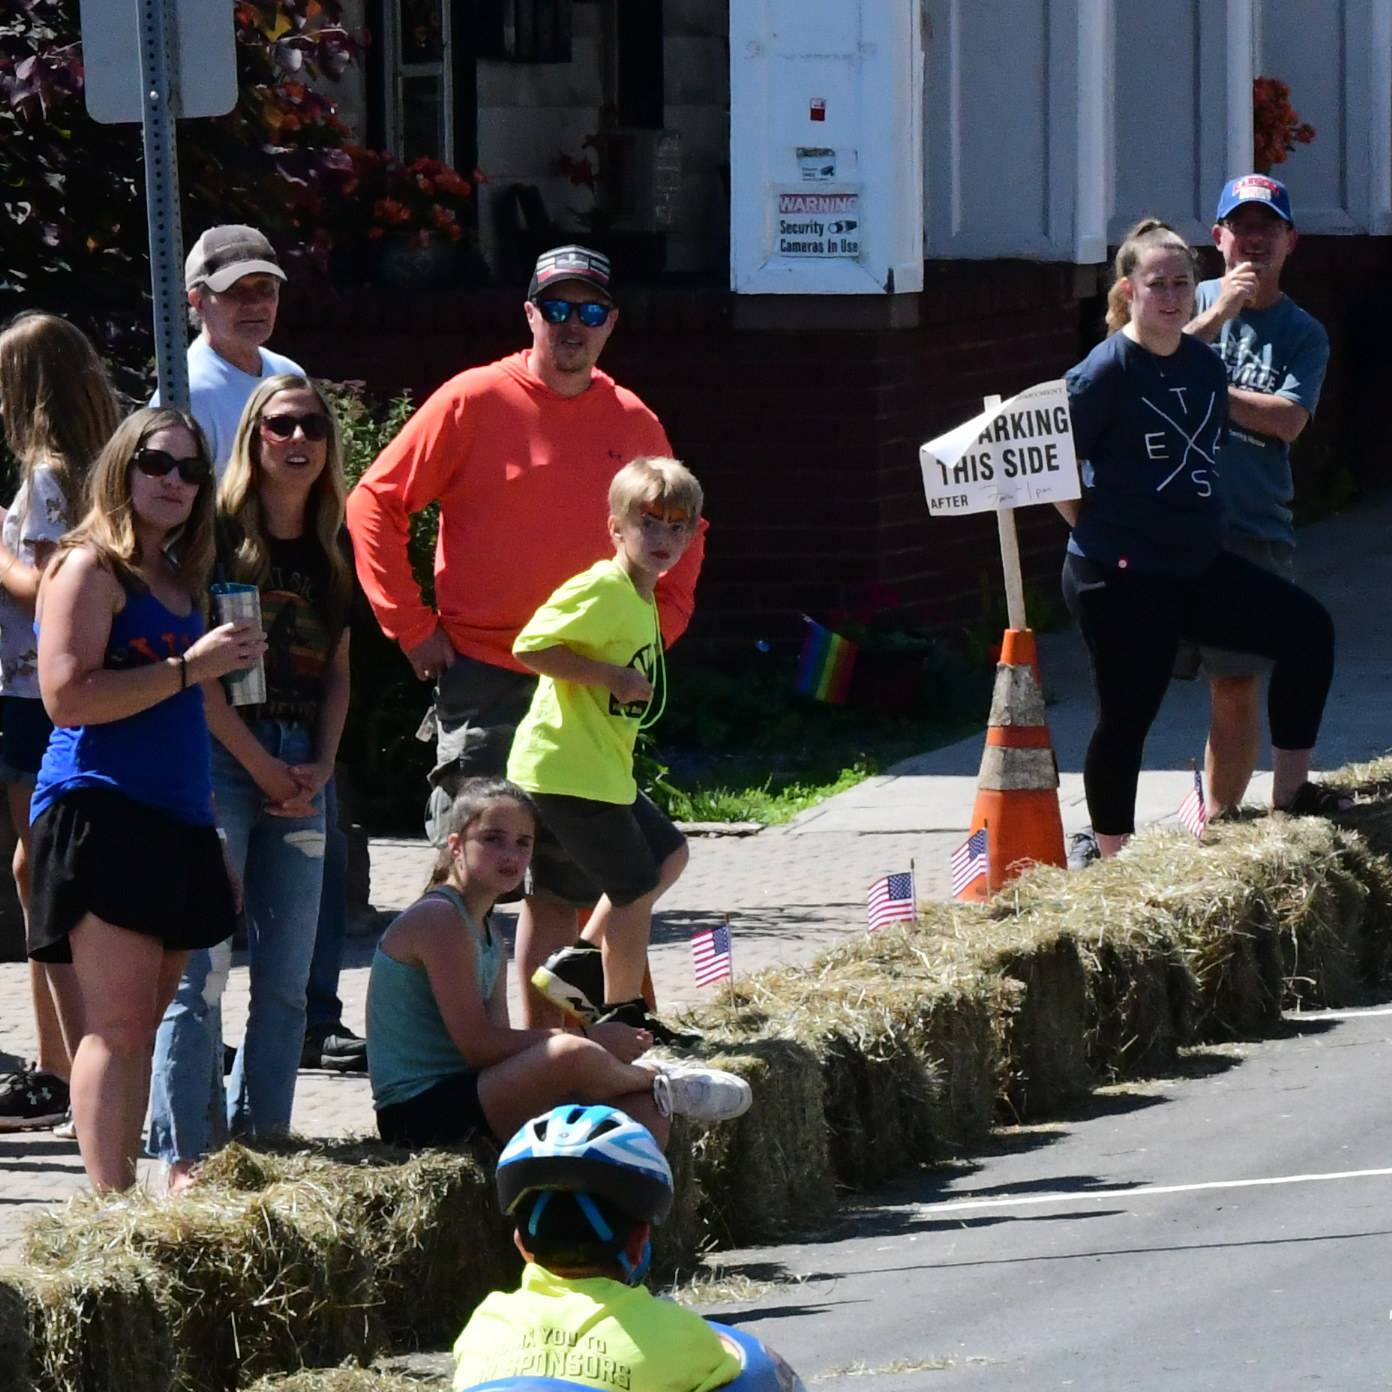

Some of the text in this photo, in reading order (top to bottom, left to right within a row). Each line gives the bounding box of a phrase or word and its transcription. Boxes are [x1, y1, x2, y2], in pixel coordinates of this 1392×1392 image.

[780, 220, 824, 237] Security
[780, 238, 858, 253] Cameras In Use
[978, 406, 1070, 445] ARKING
[936, 443, 1060, 486] THIS SIDE
[931, 494, 969, 510] AFTER
[542, 1325, 579, 1348] YOU
[586, 1335, 607, 1355] TO
